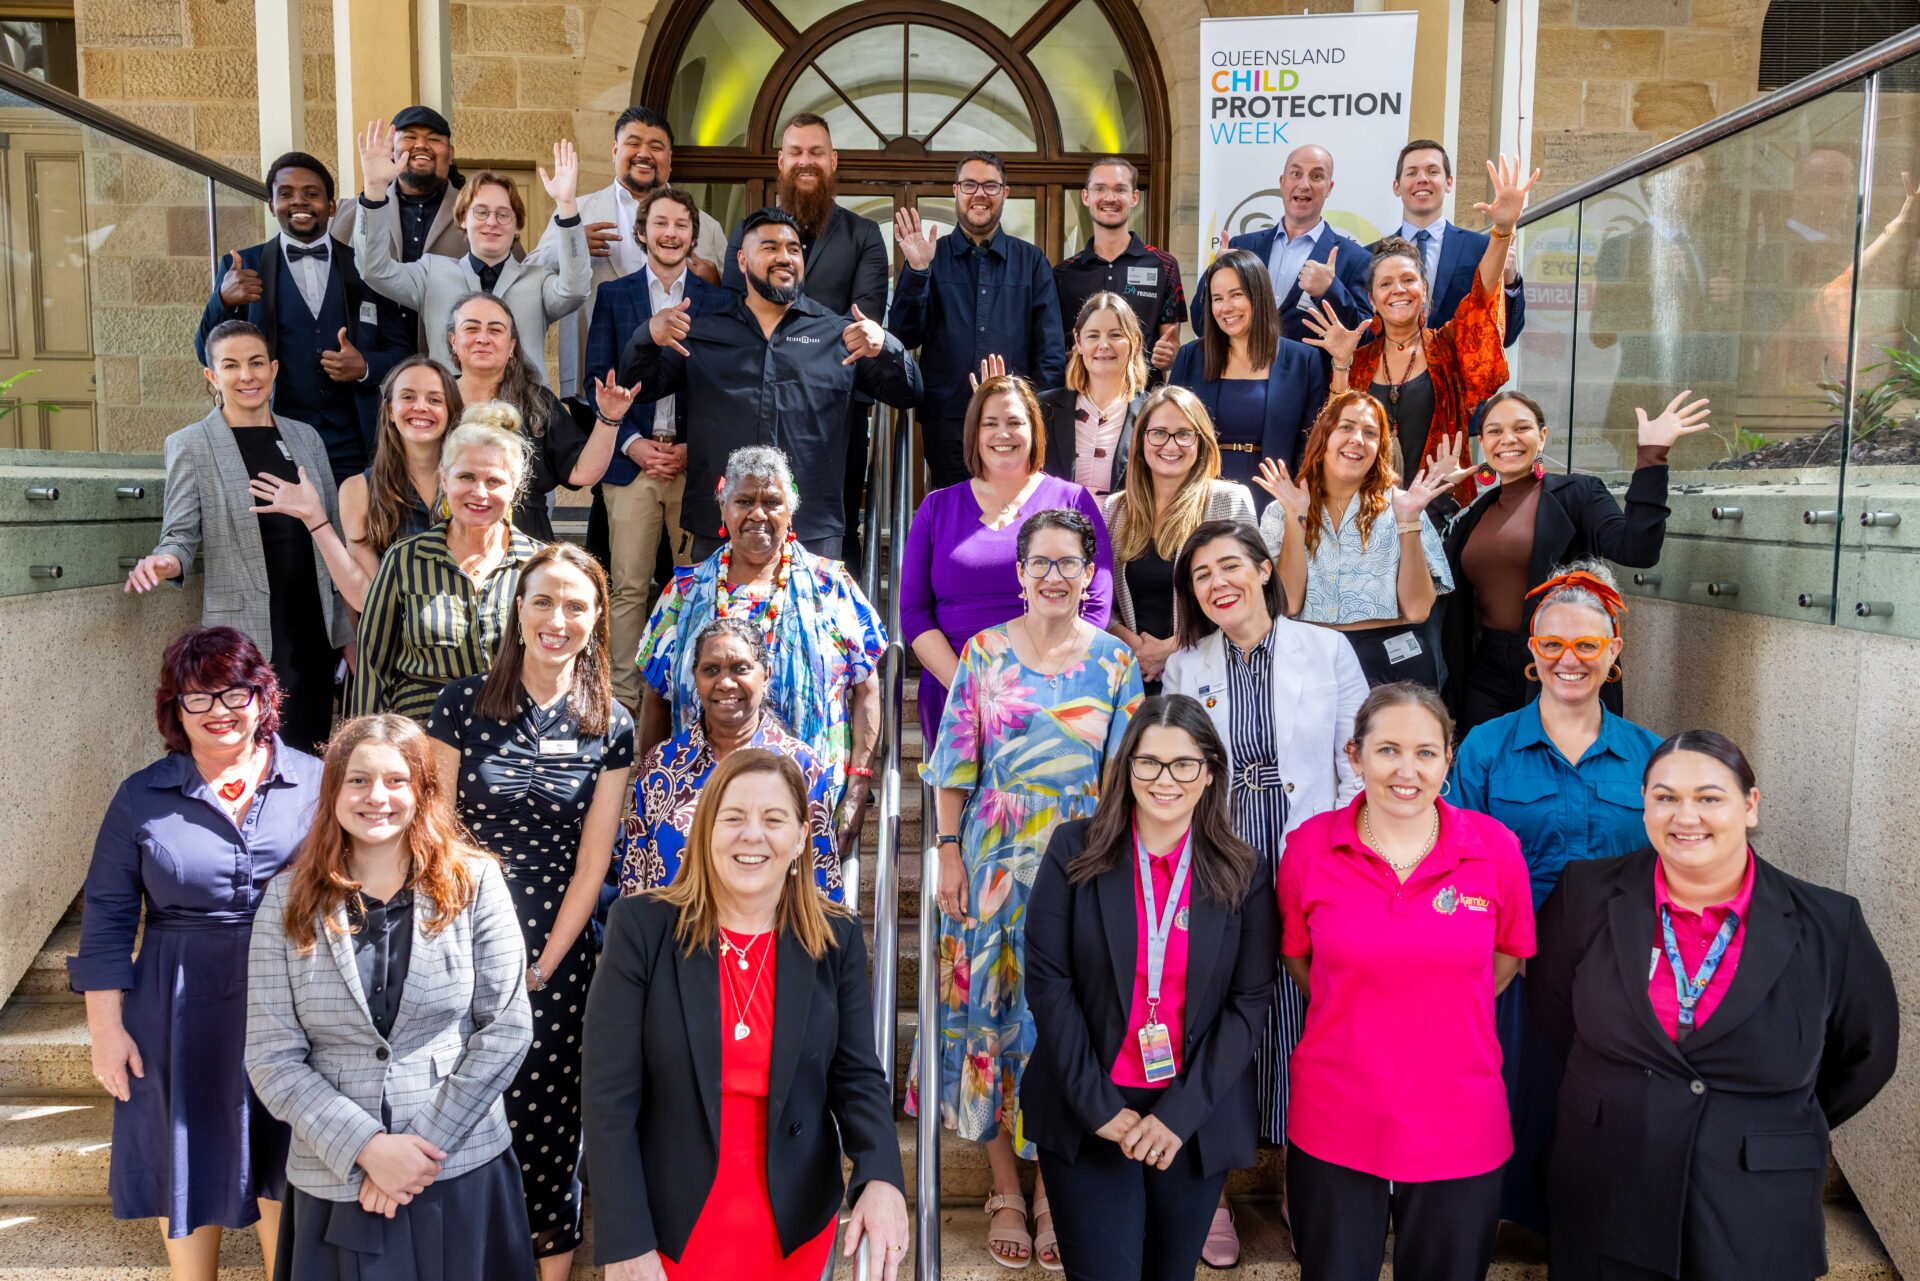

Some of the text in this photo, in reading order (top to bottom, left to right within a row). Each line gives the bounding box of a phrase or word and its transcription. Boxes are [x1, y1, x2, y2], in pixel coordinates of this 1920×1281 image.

[1212, 48, 1345, 67] QUEENSLAND
[1212, 70, 1299, 93] CHILD
[1212, 92, 1402, 118] PROTECTION
[1210, 122, 1289, 144] WEEK
[1137, 290, 1157, 298] reasons
[1460, 893, 1489, 907] kambu
